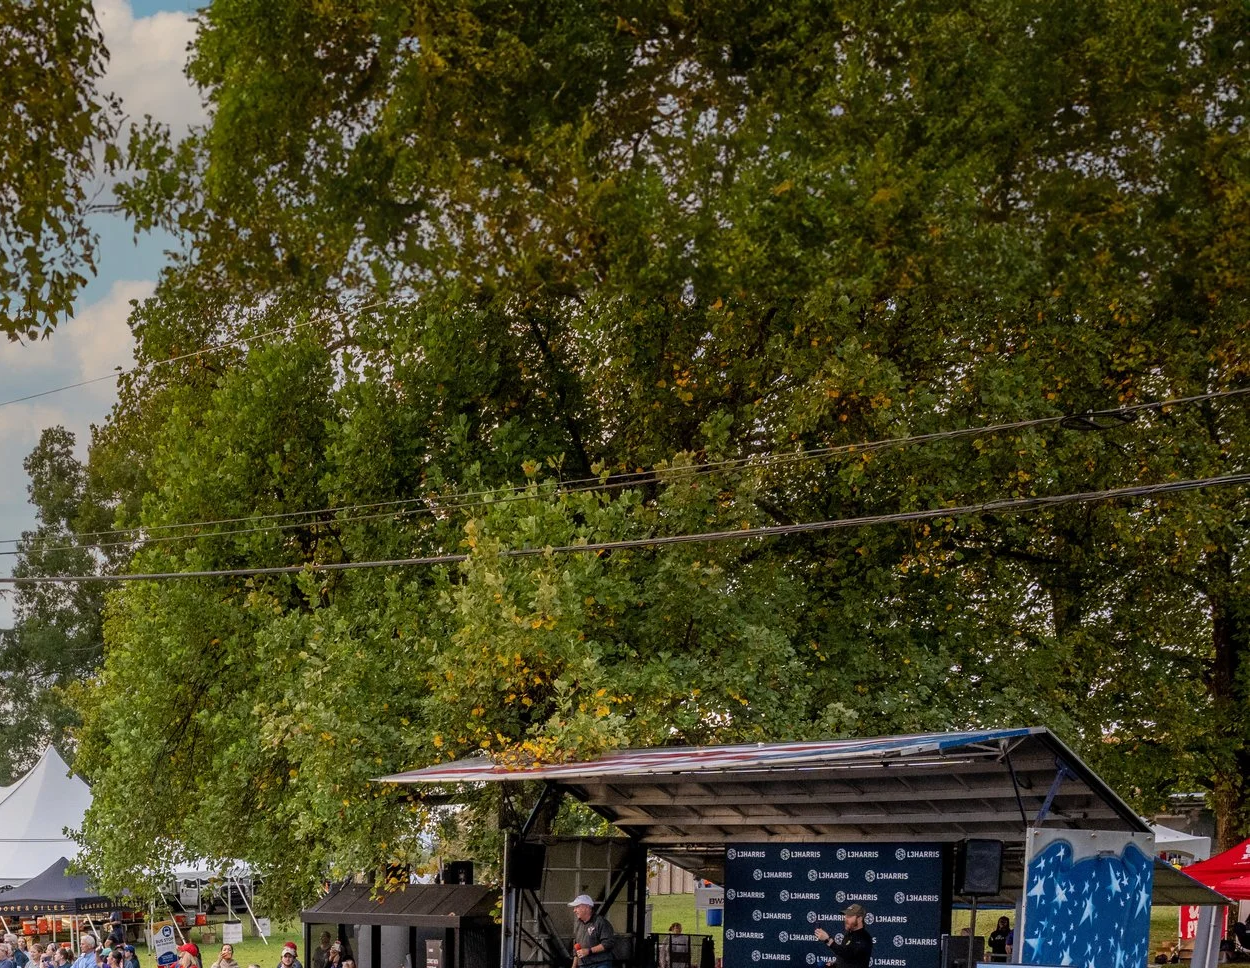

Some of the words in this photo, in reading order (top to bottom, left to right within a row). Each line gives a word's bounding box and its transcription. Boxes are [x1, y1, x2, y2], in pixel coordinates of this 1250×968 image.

[877, 872, 908, 880] L3HARRIS
[790, 892, 820, 900] L3HARRIS
[906, 894, 939, 902] L3HARRIS
[905, 938, 937, 946] L3HARRIS
